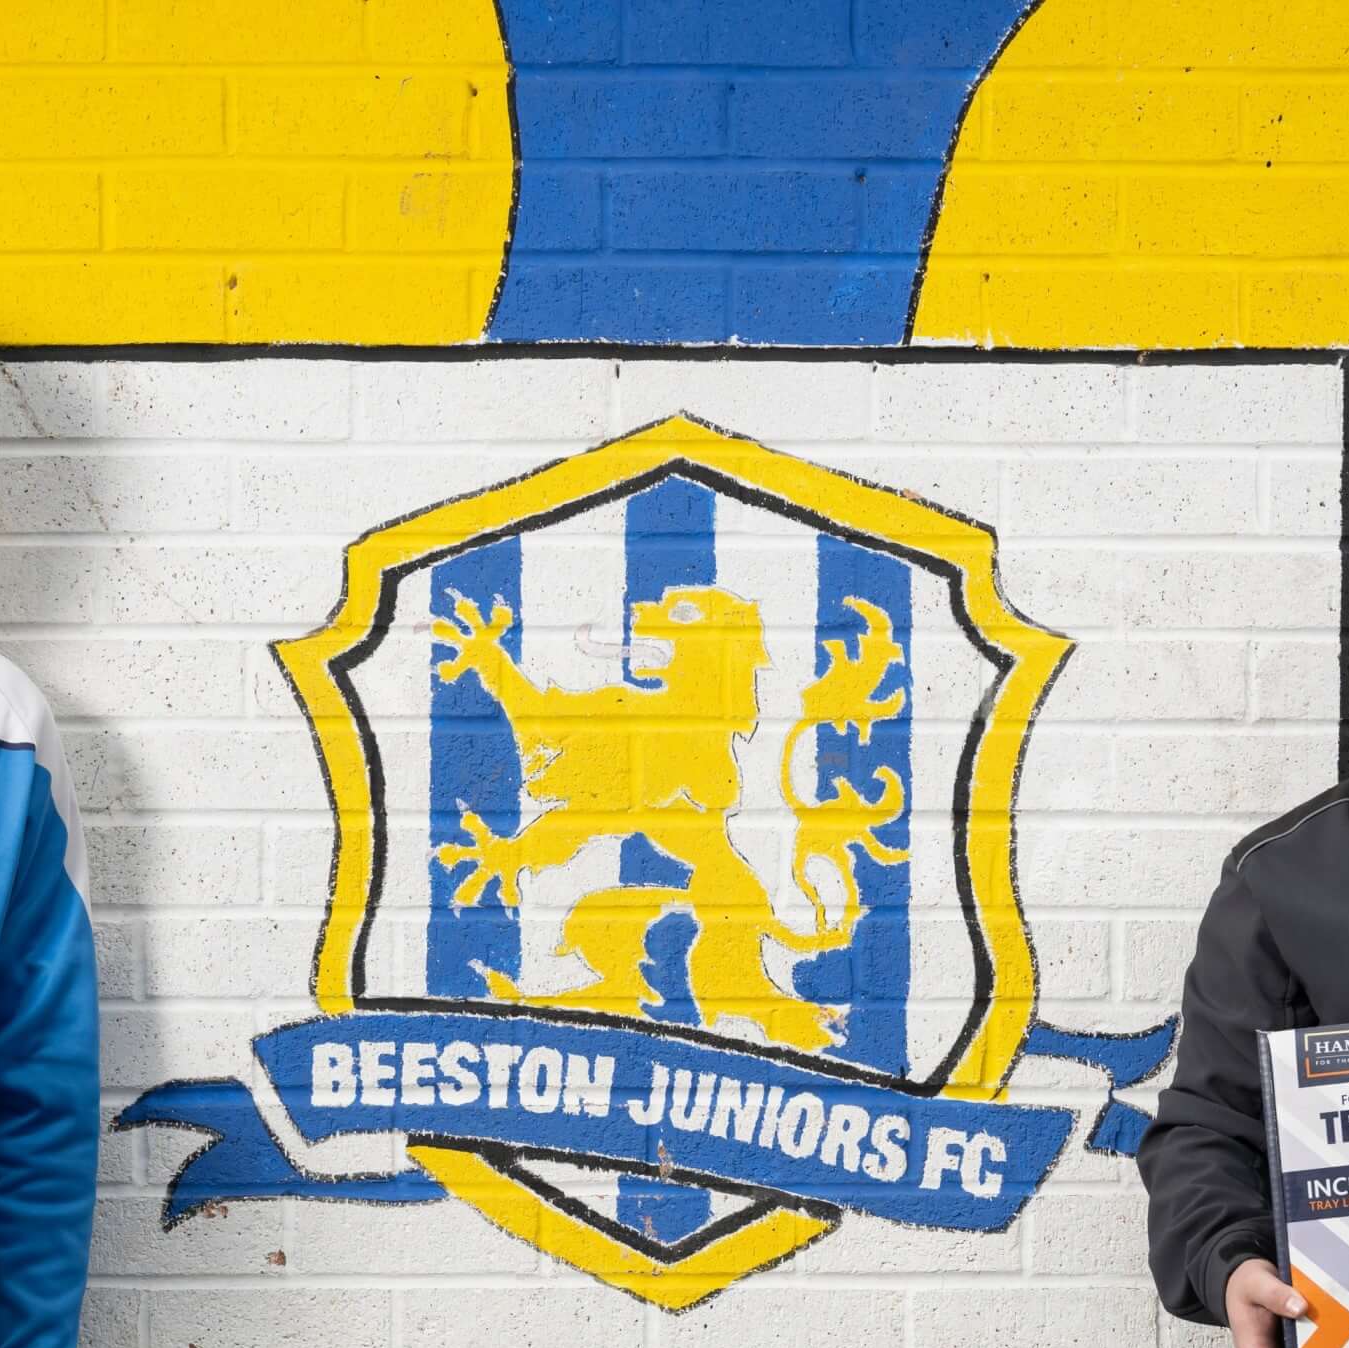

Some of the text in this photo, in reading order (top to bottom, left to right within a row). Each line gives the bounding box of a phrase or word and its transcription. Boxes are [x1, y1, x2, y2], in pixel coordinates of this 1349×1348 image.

[1315, 1058, 1330, 1066] FOR
[311, 1040, 1007, 1199] BEESTON JUNIORS FC
[1308, 1200, 1340, 1211] TRAY
